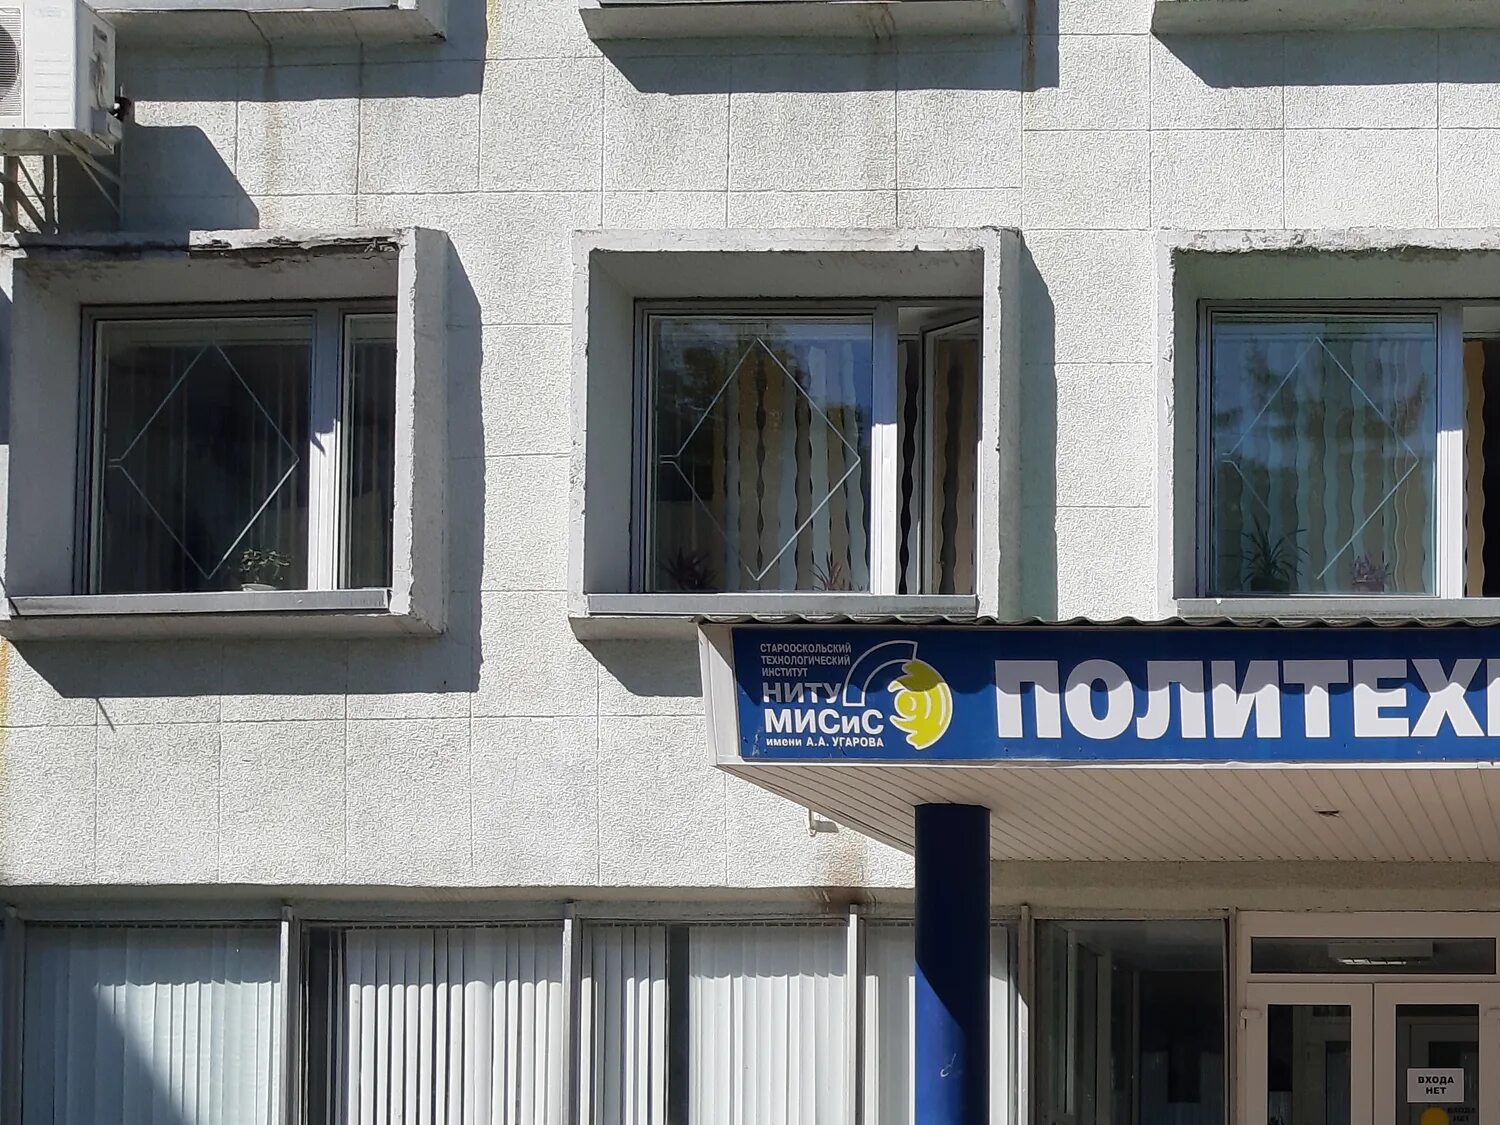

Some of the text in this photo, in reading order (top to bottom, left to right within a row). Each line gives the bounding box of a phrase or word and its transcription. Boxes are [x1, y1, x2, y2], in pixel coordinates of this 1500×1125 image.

[760, 642, 851, 653] СТАРООСКОЛЬСКИЙ
[761, 655, 850, 666] ТЕХНОЛОГИЧЕСКИЙ
[761, 667, 808, 677] ИНСТИТУТ
[763, 682, 842, 704] НИТУ
[764, 708, 884, 735] МИСиС
[766, 737, 884, 747] имени А.А. УГАРОВА
[1418, 1076, 1454, 1085] ВХОДА
